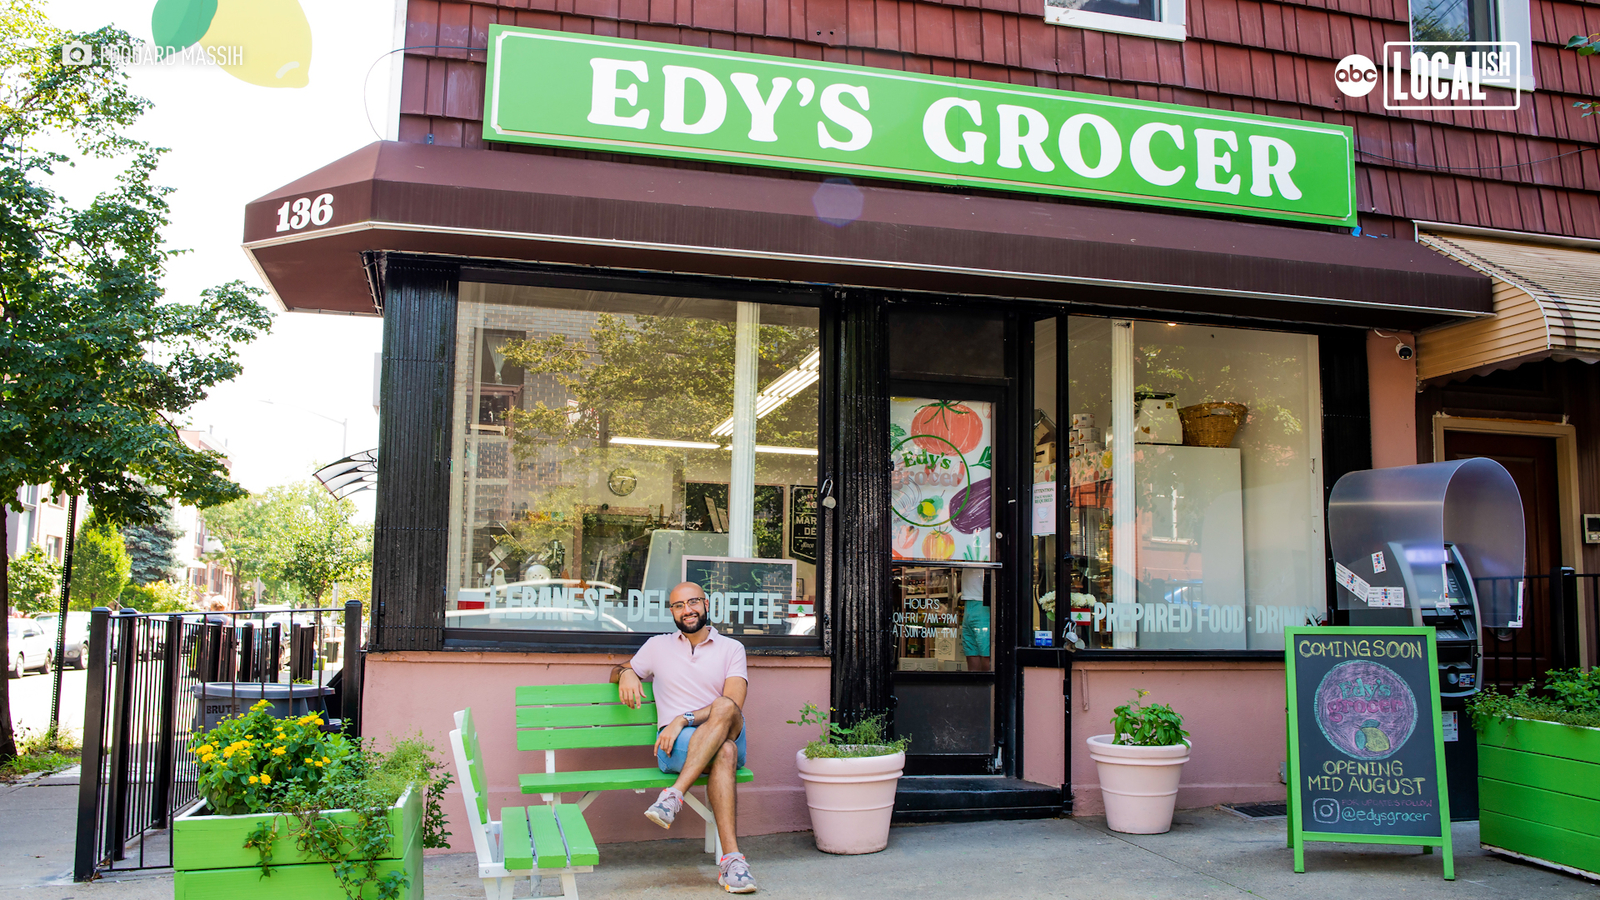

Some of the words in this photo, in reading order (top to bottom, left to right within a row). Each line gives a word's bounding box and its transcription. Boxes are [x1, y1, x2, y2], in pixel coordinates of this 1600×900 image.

[586, 57, 873, 152] EDY'S
[922, 96, 1303, 201] GROCER
[276, 193, 334, 233] 136
[901, 448, 952, 470] Edy's
[891, 468, 964, 490] grocer
[796, 516, 817, 525] MAR
[804, 527, 817, 536] DE
[489, 585, 615, 622] LEBANESE
[627, 588, 674, 623] DEL
[704, 591, 783, 625] OFFEE
[904, 598, 940, 609] HOURS
[892, 612, 918, 623] ON-FRI
[1093, 602, 1193, 633] PREPARED
[1196, 603, 1244, 634] FOOD
[1299, 639, 1371, 658] COMING
[1373, 639, 1423, 660] SOON
[1338, 677, 1391, 700] Edy's
[207, 704, 240, 714] BRUTE
[1327, 699, 1404, 723] grocer
[1322, 759, 1404, 777] OPENING
[1307, 775, 1344, 792] MID
[1348, 776, 1426, 796] AUGUST
[1341, 806, 1433, 827] @edysgrocer
